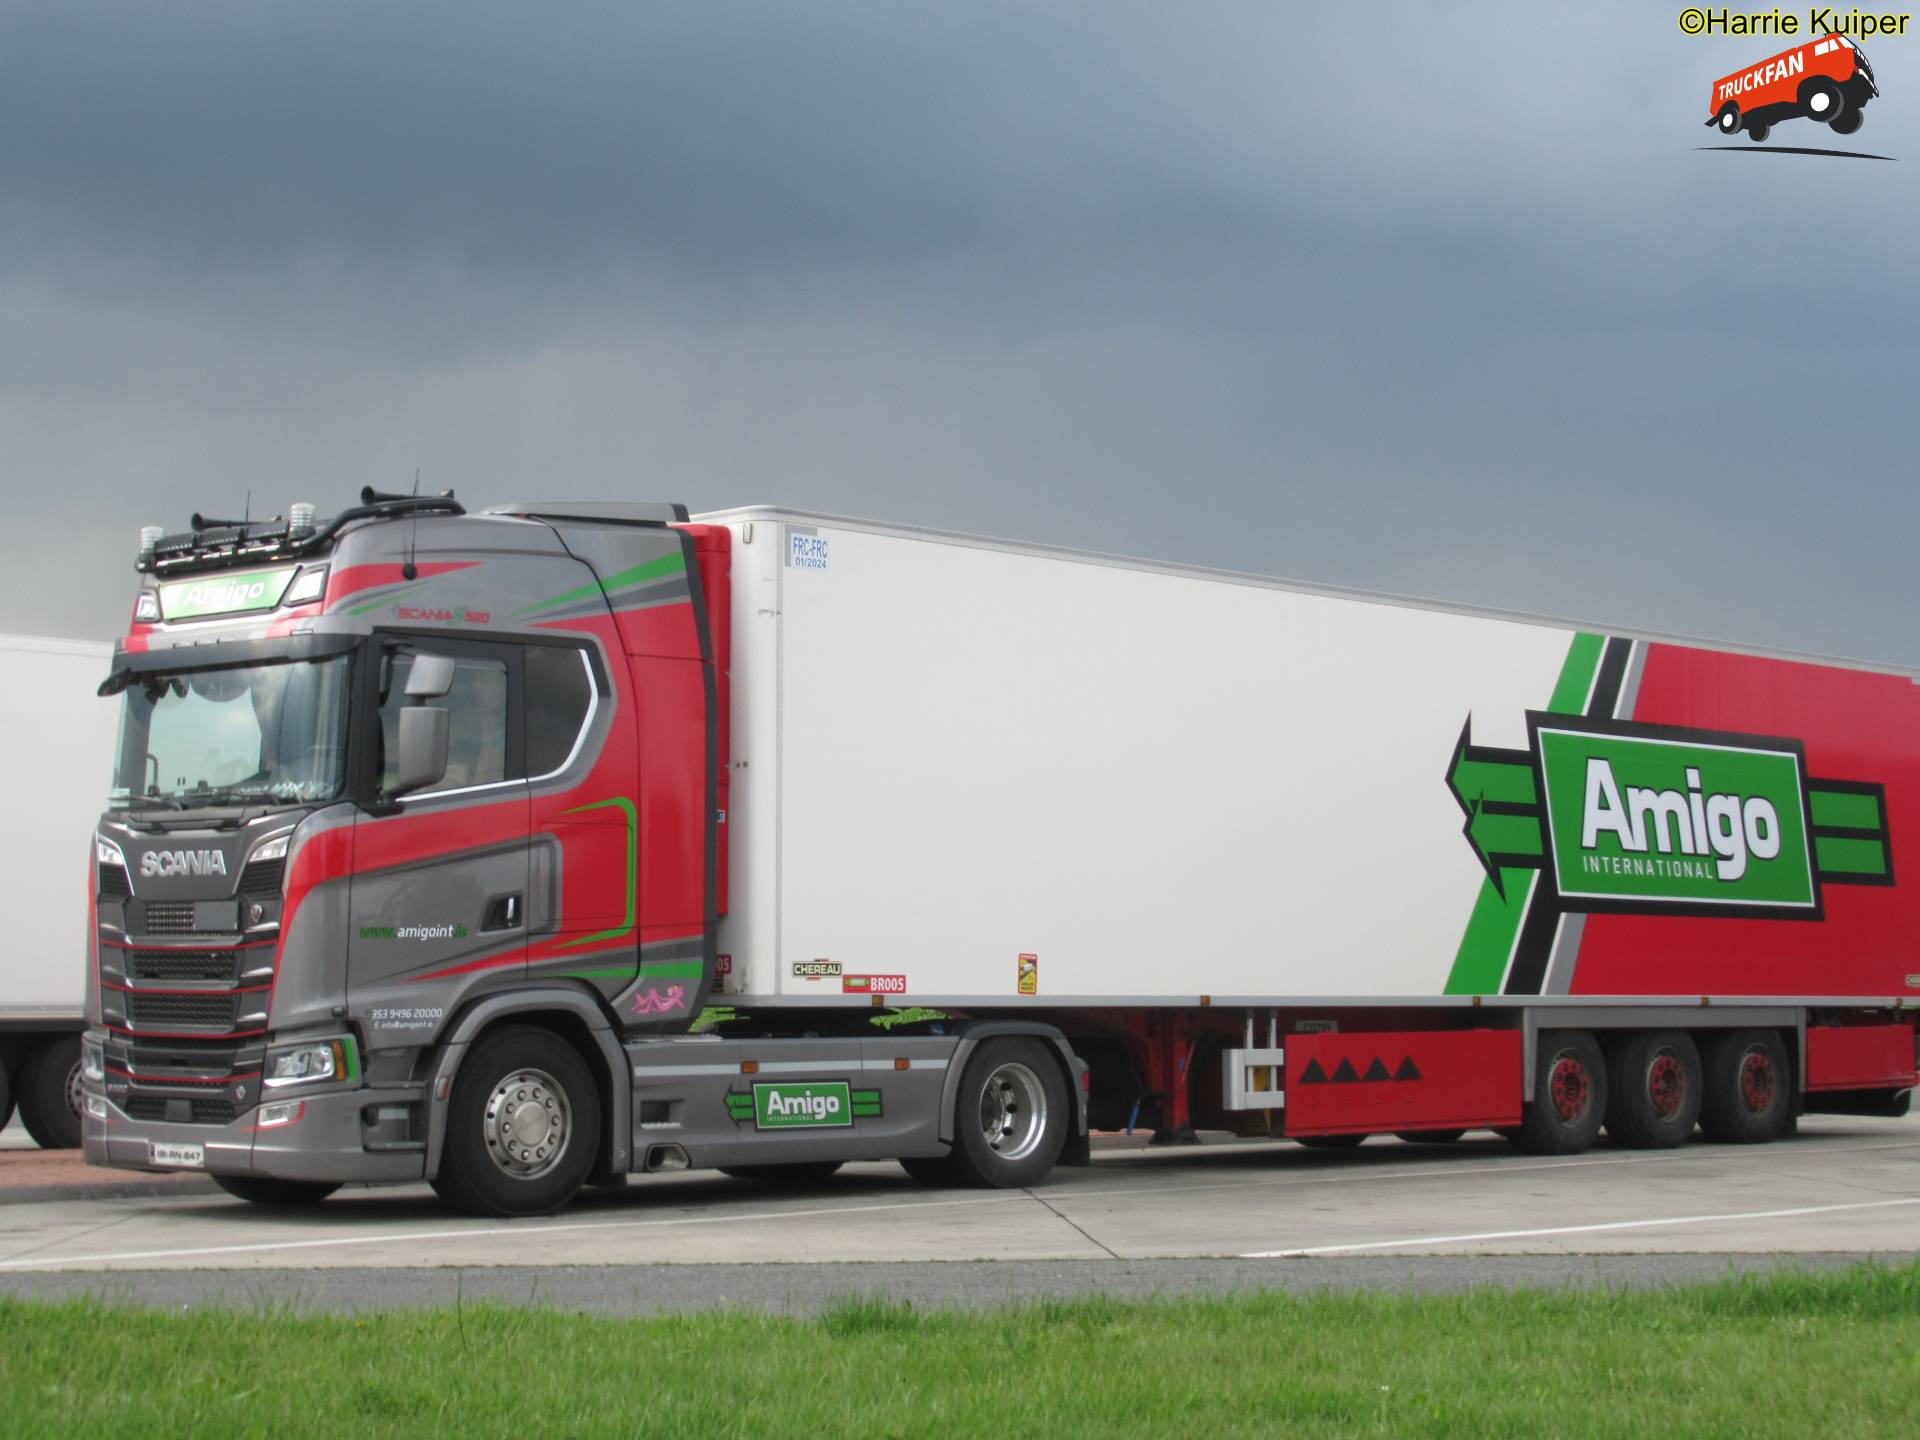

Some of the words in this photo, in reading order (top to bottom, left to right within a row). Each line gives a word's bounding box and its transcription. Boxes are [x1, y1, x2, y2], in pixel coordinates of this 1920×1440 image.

[793, 536, 828, 558] FRC-FRC
[795, 556, 826, 569] 01/2024
[182, 579, 265, 609] Amigo
[397, 607, 454, 621] SCANIA
[1581, 756, 1781, 882] Amigo
[140, 849, 227, 877] SCANIA
[1582, 855, 1714, 880] INTERNATIONAL
[794, 963, 841, 976] CHEREAU
[869, 977, 905, 992] BR005
[371, 1008, 388, 1020] 353
[389, 1008, 412, 1020] 9496
[413, 1007, 443, 1019] 20000
[766, 1090, 841, 1120] Amigo
